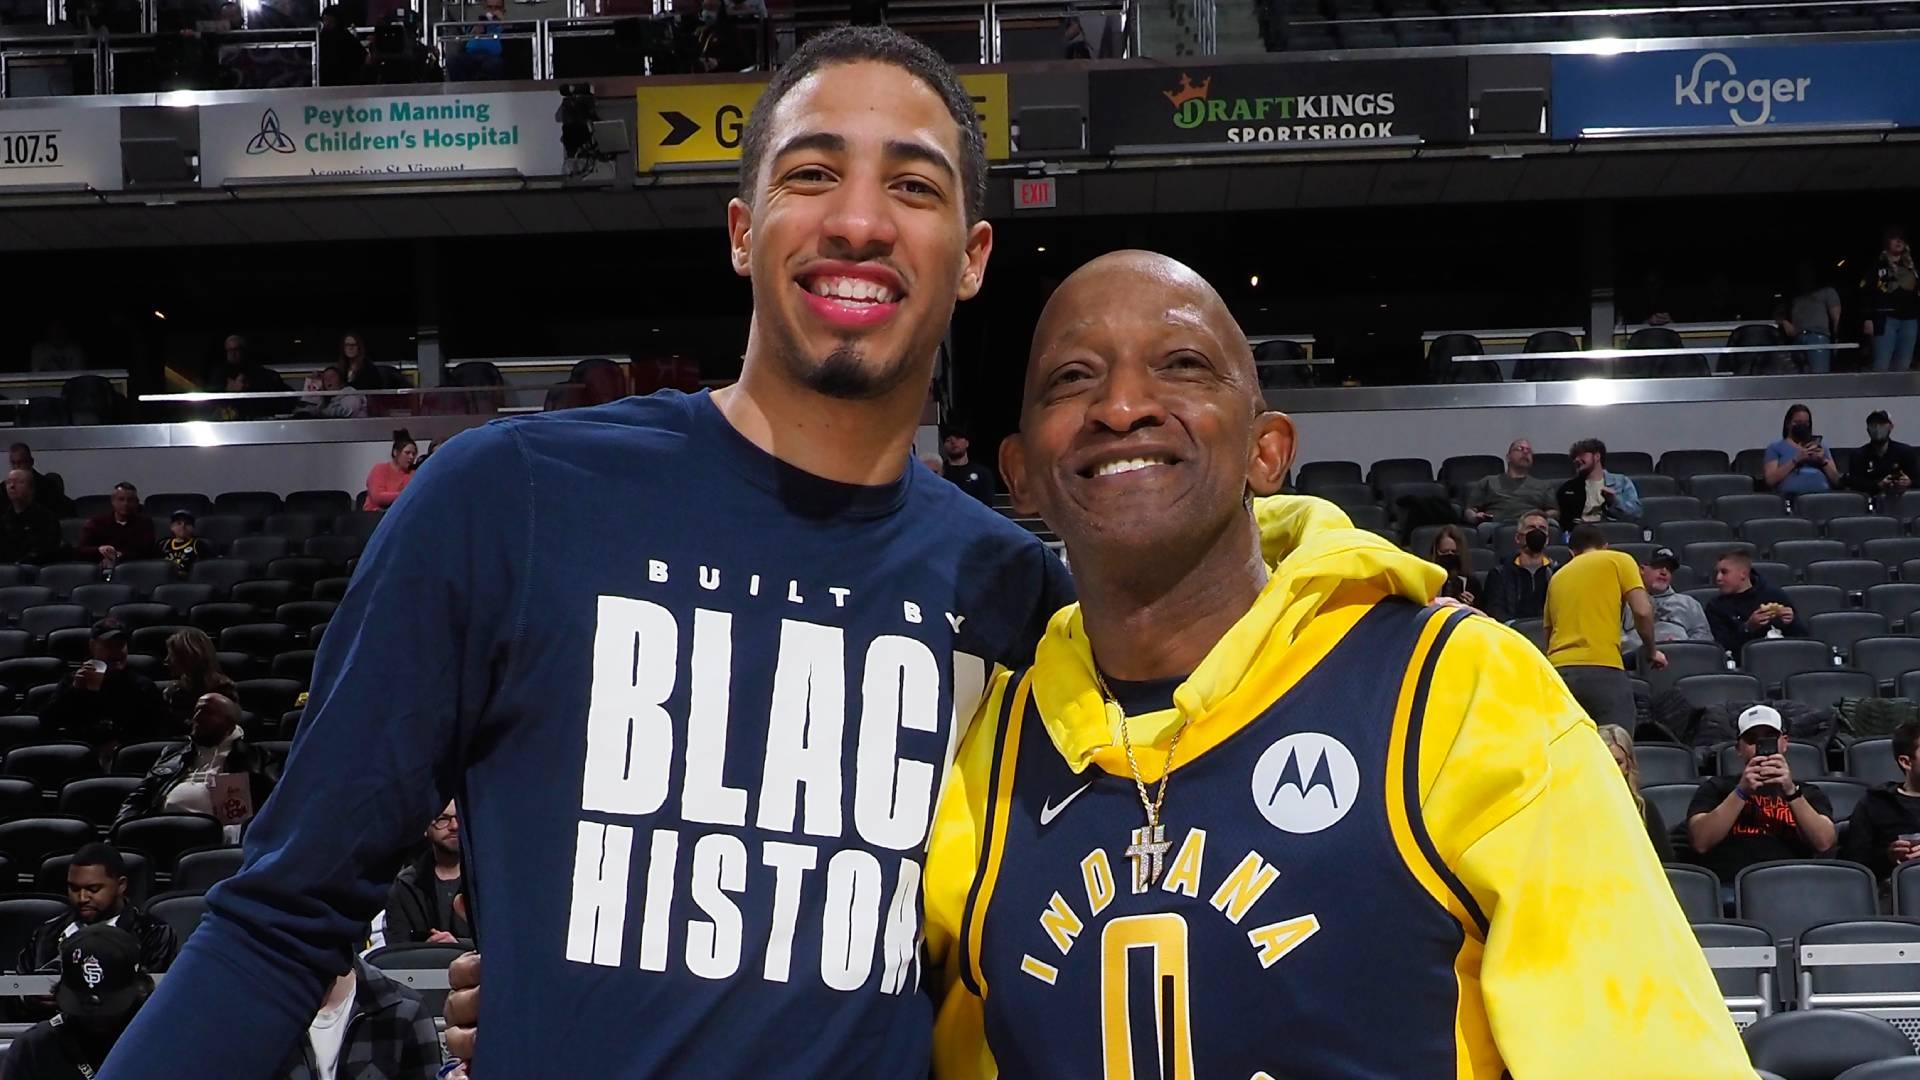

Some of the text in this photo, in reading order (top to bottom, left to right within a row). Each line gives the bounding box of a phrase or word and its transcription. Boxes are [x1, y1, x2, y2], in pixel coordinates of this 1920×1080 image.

[1676, 52, 1811, 126] Kroger
[304, 100, 490, 128] Peyton Manning
[1173, 92, 1395, 128] DRAFTKINGS
[304, 125, 519, 152] Children's Hospital
[1227, 122, 1393, 143] SPORTSBOOK
[3, 134, 58, 164] 107.5
[1022, 182, 1048, 205] EXIT
[648, 559, 966, 634] BUILT BY
